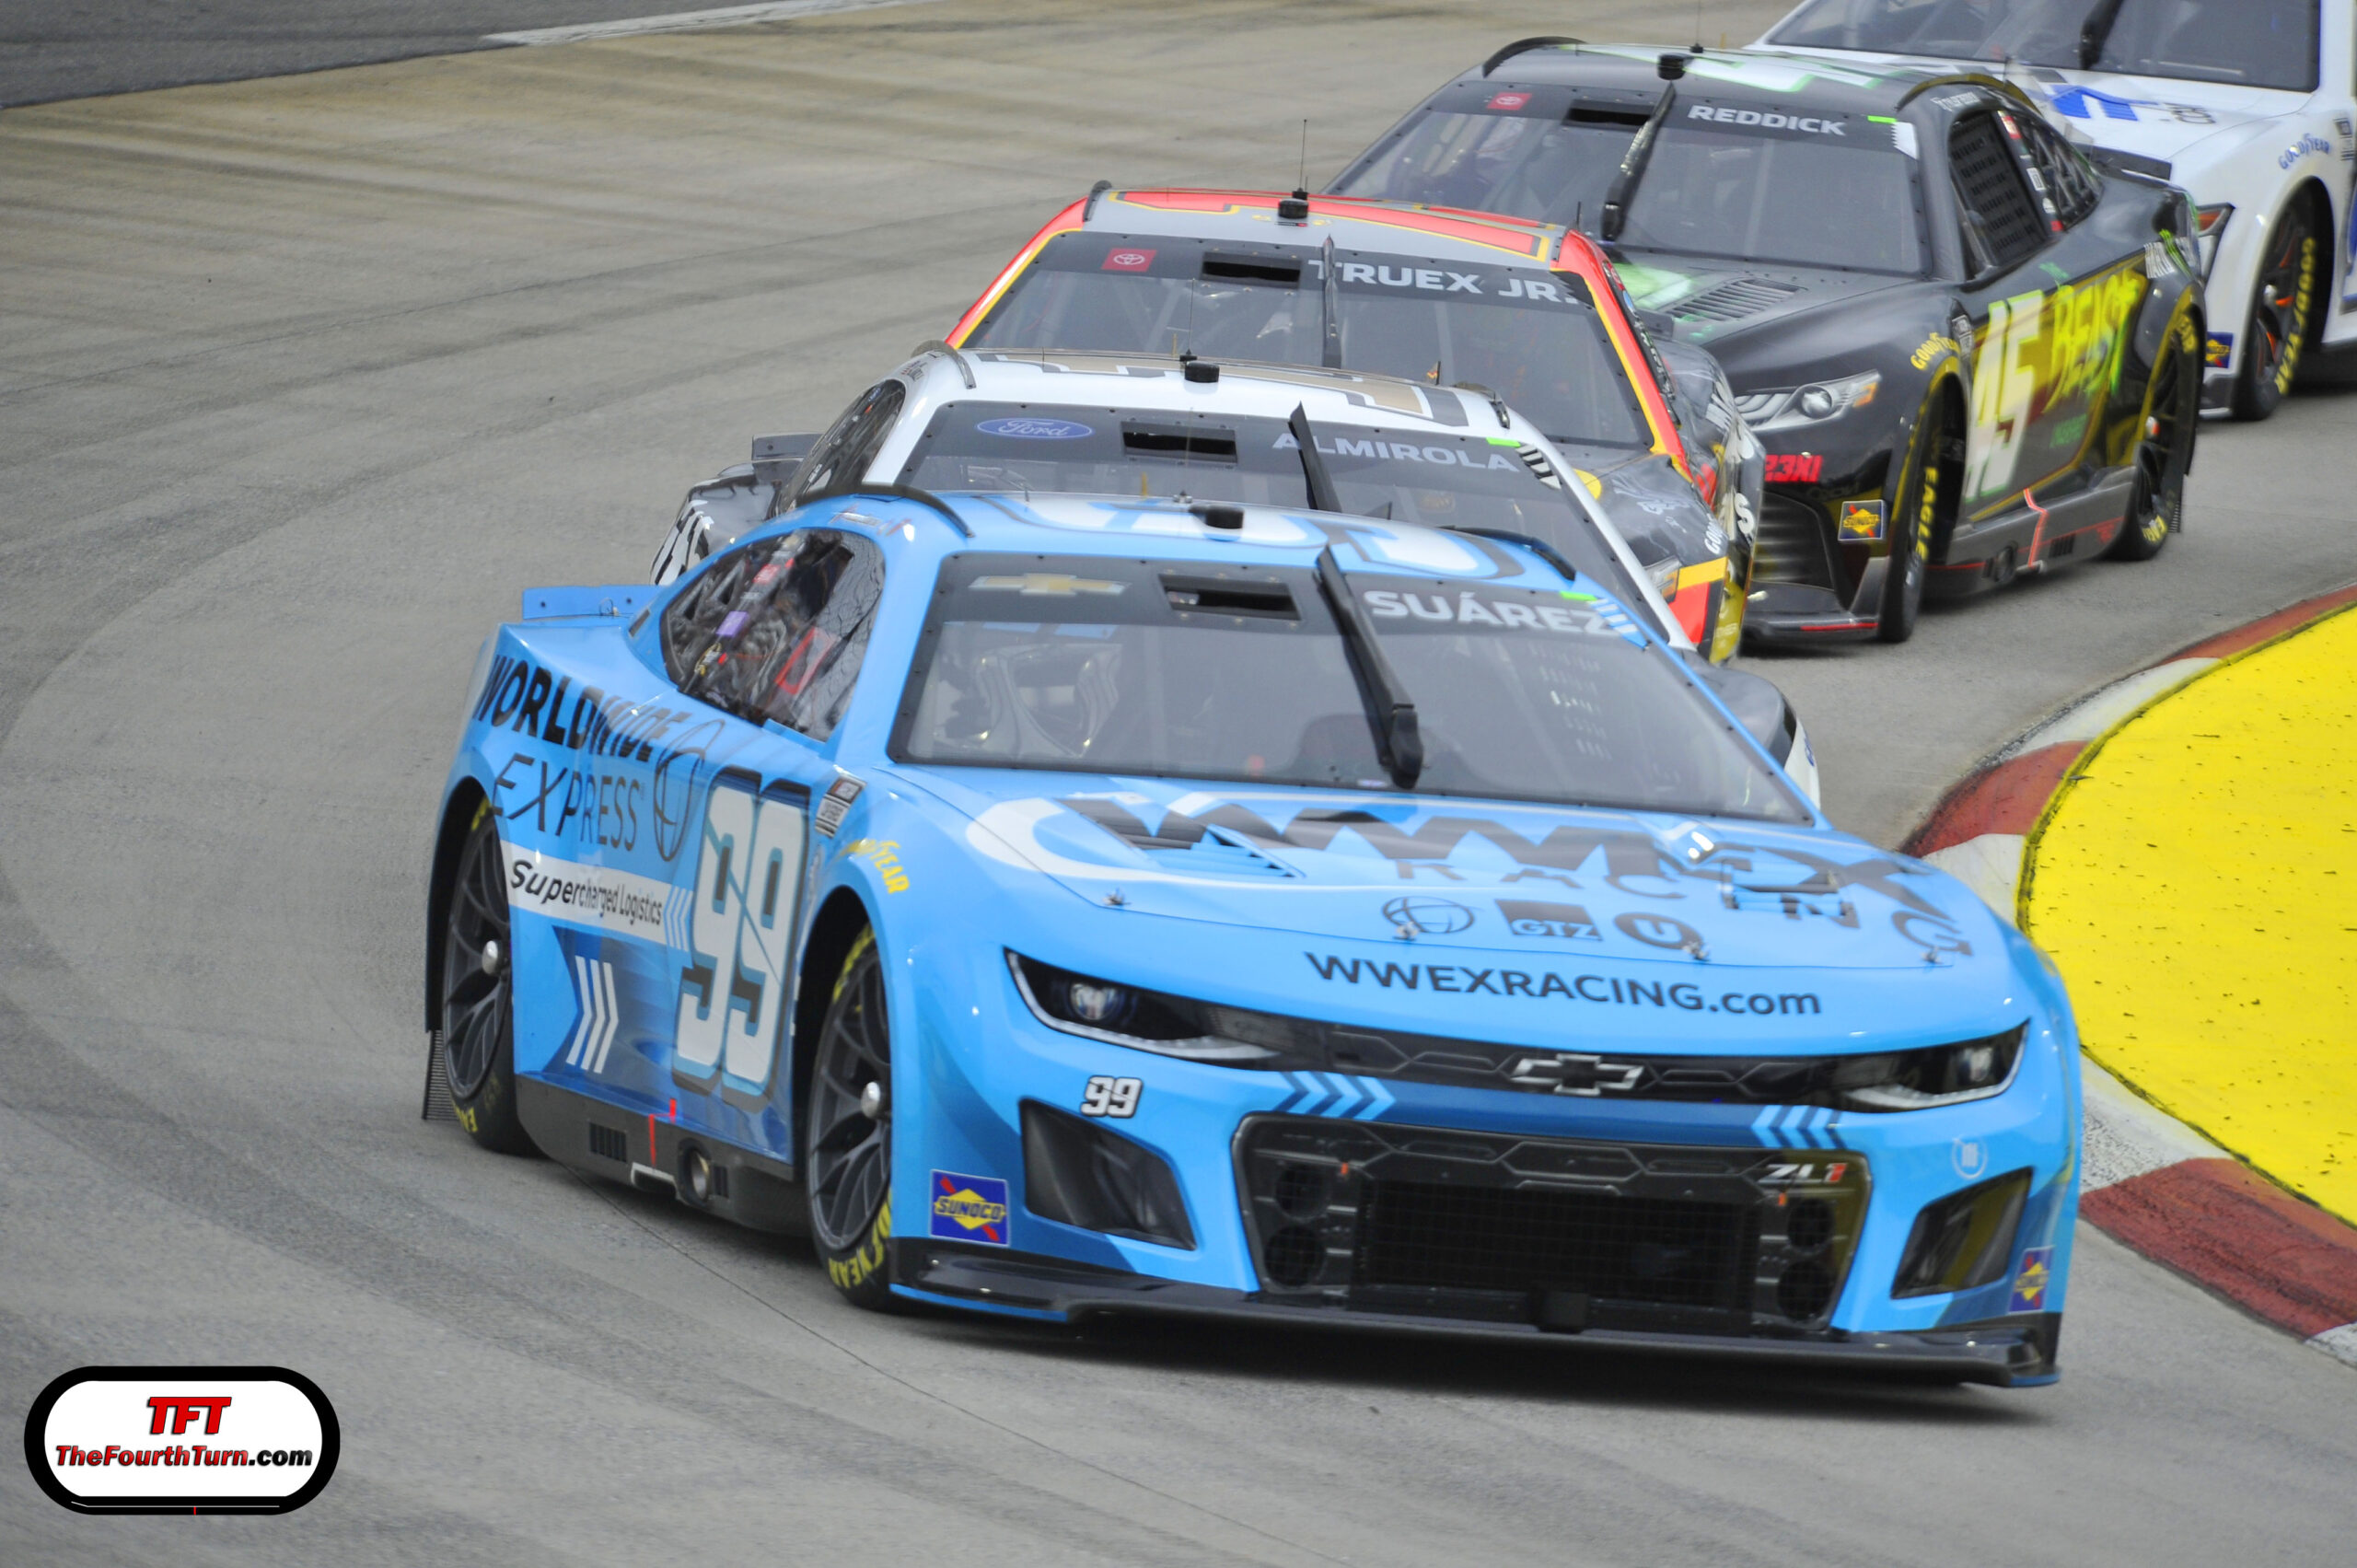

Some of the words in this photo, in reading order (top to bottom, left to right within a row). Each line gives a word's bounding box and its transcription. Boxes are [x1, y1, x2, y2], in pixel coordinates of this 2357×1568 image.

[1688, 104, 1847, 136] REDDICK
[1307, 260, 1483, 295] TRUEX
[1498, 277, 1579, 305] JR.
[997, 419, 1072, 437] Ford
[1272, 432, 1521, 472] ALMIROLA
[1915, 467, 1939, 563] EAGLE
[1364, 589, 1621, 637] SUÁREZ
[473, 654, 692, 763] WORLDWIDE
[493, 751, 641, 853] EXPRESS
[510, 859, 621, 919] Supercharged
[620, 883, 663, 925] Logistics
[671, 764, 812, 1116] 99
[1304, 951, 1820, 1015] WWEXRACING.com
[1080, 1074, 1144, 1119] 99
[1758, 1162, 1848, 1184] ZL1
[936, 1198, 1004, 1221] SUNOCO
